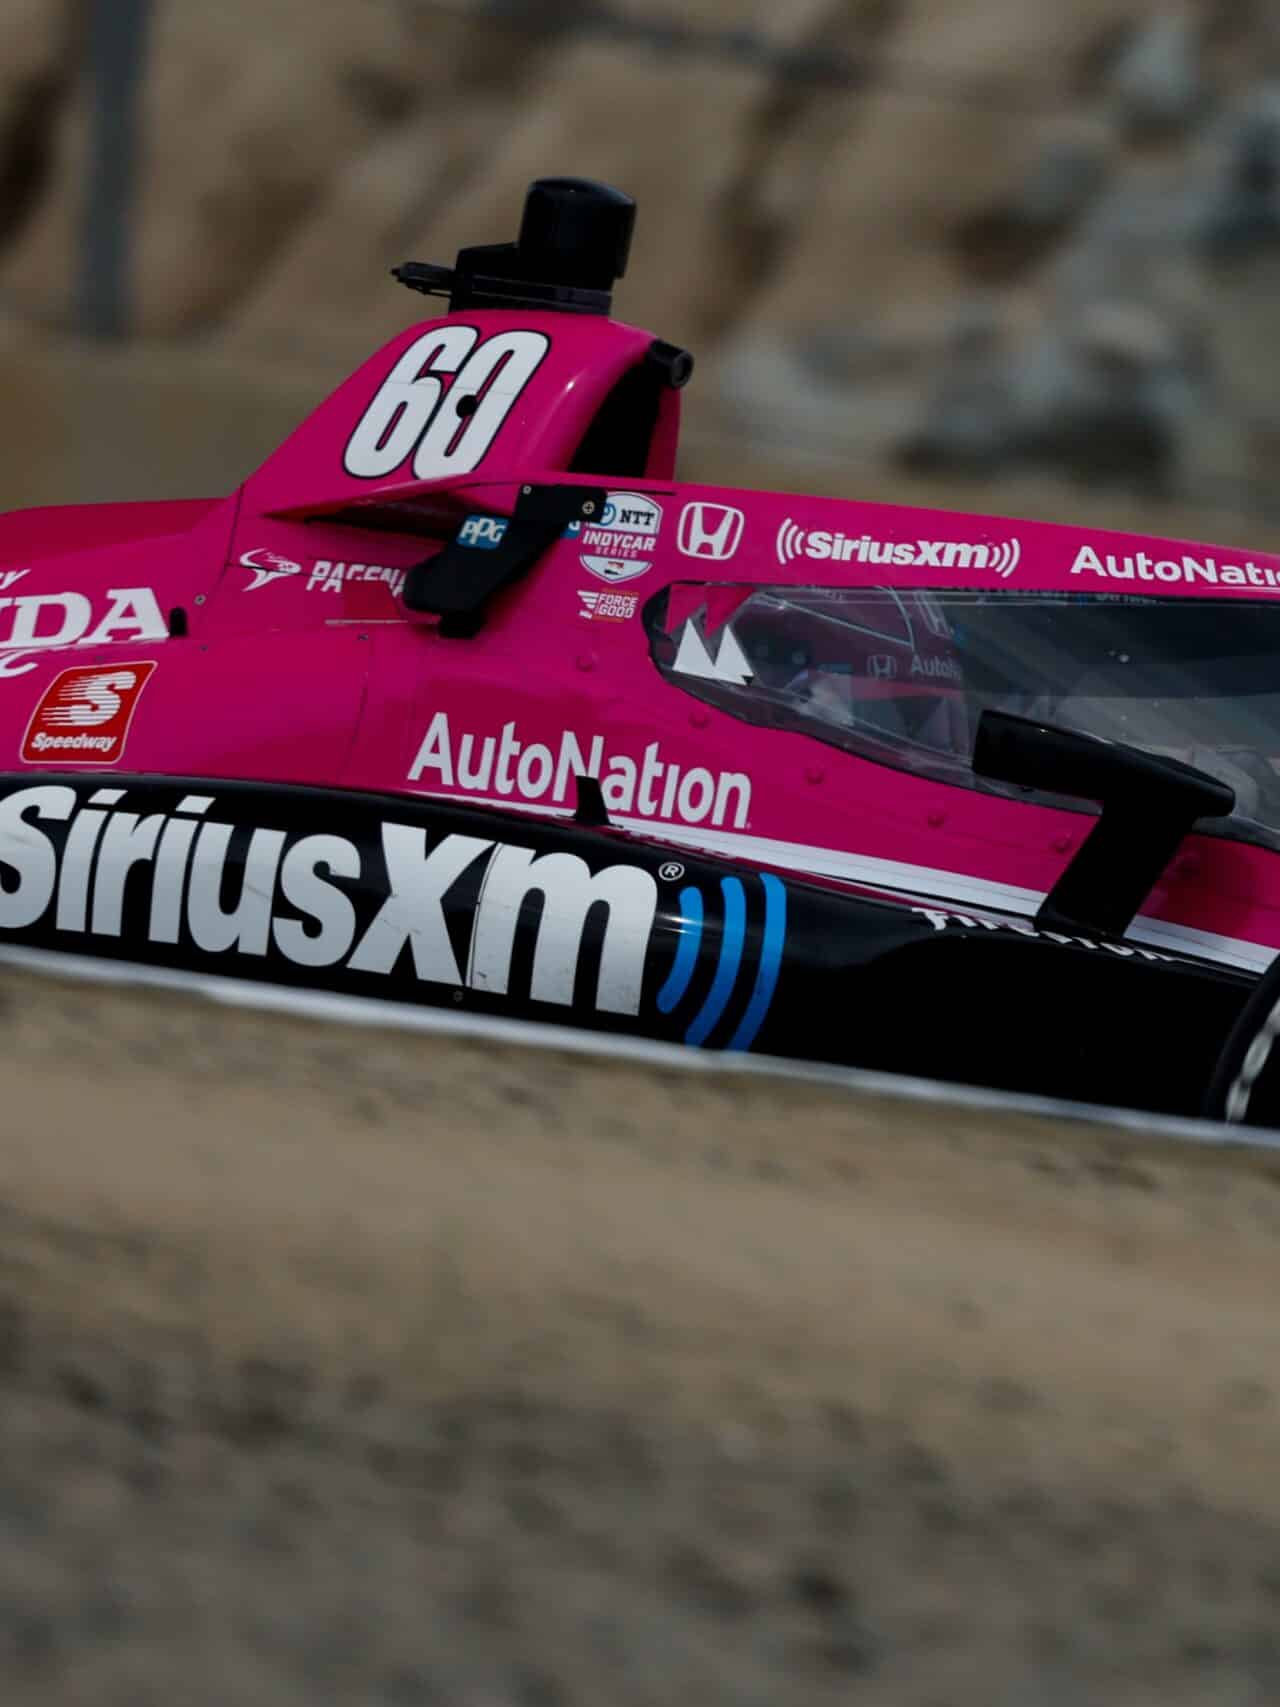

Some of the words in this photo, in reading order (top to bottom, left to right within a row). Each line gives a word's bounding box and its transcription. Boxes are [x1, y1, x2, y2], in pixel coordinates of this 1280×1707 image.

[344, 326, 550, 480] 60
[620, 510, 655, 526] NTT
[459, 517, 508, 545] PPG
[583, 530, 657, 551] INDYCAR
[598, 594, 639, 609] FORCE
[598, 604, 635, 619] GOOD
[31, 732, 118, 752] Speedway
[407, 712, 752, 829] AutoNation
